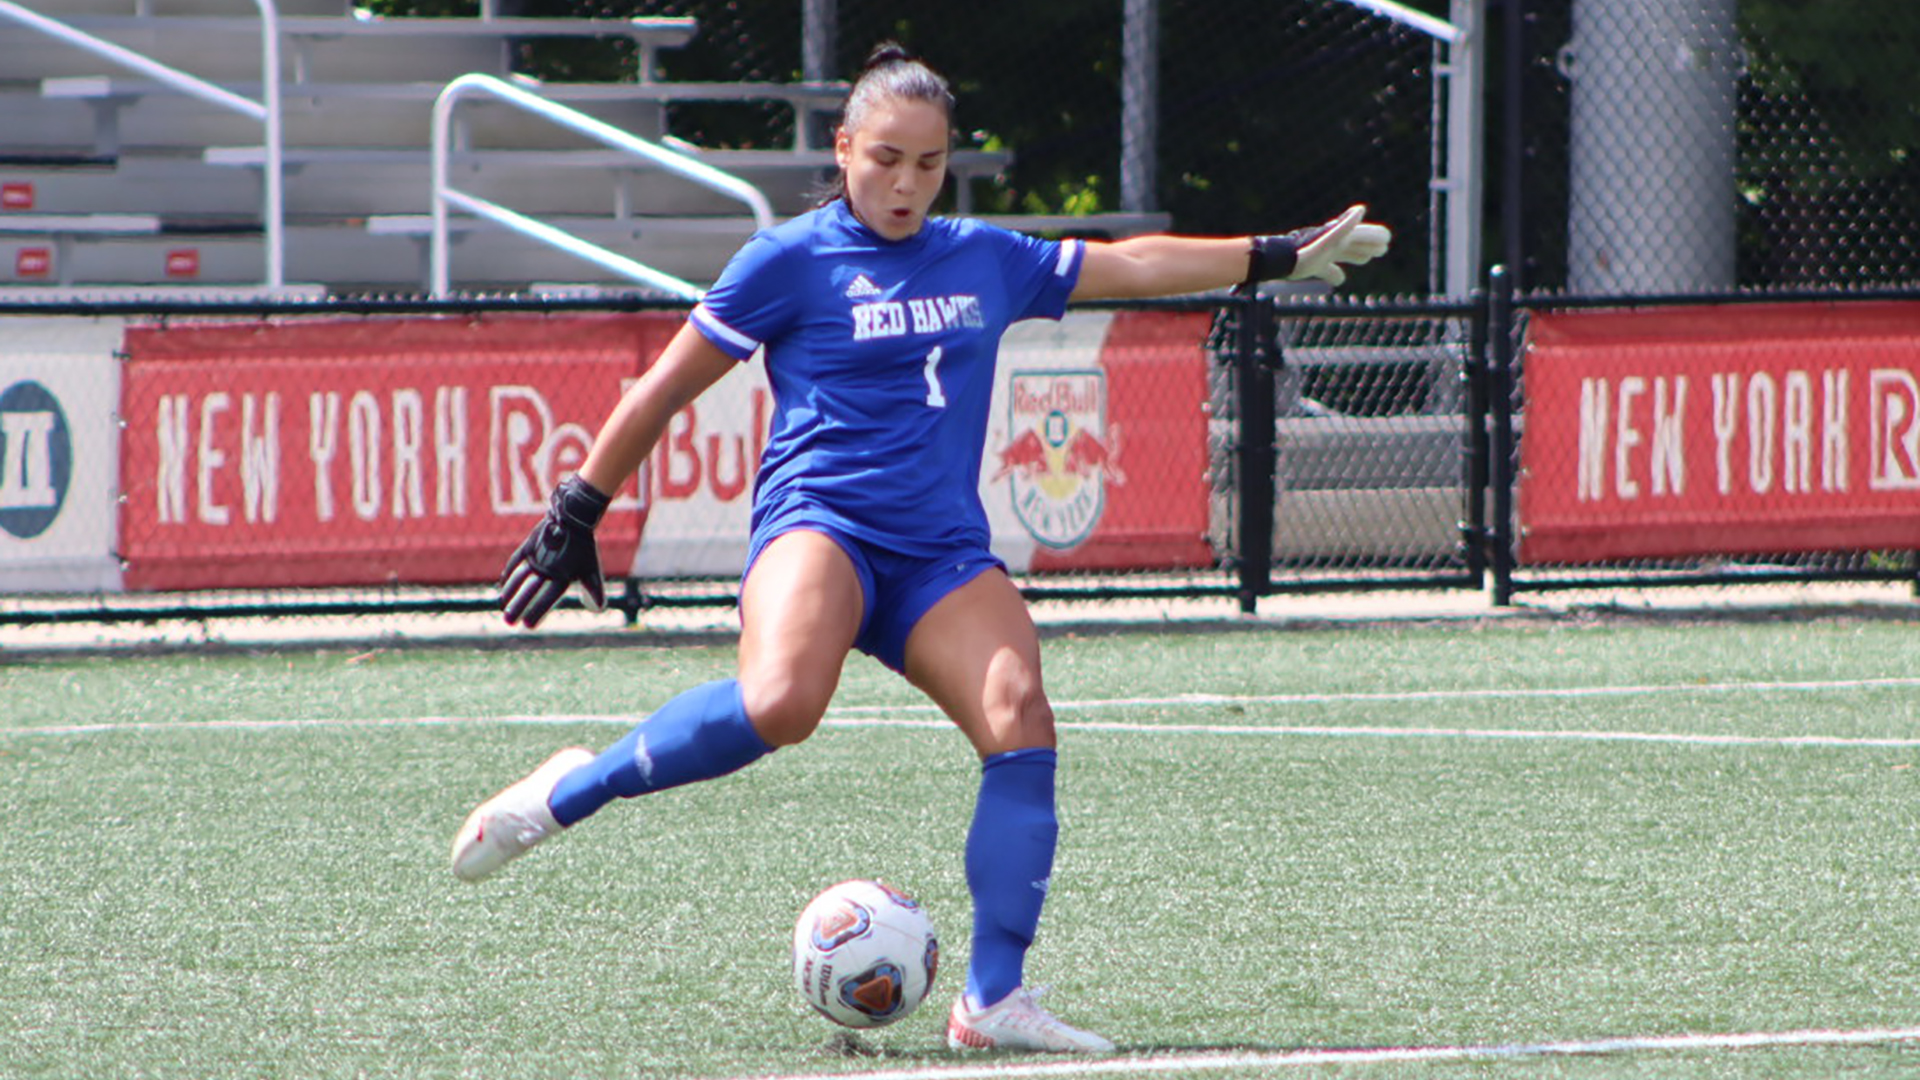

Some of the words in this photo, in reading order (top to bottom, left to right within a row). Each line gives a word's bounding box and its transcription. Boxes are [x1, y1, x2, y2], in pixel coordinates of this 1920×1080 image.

[852, 302, 906, 341] RED
[908, 295, 983, 334] HAWKS
[924, 346, 945, 408] 1
[156, 391, 280, 525] NEW
[309, 385, 468, 522] YORK
[489, 378, 646, 515] Re
[659, 388, 766, 502] Bul
[1577, 373, 1689, 502] NEW
[1711, 368, 1849, 496] YORK
[1868, 367, 1920, 491] R
